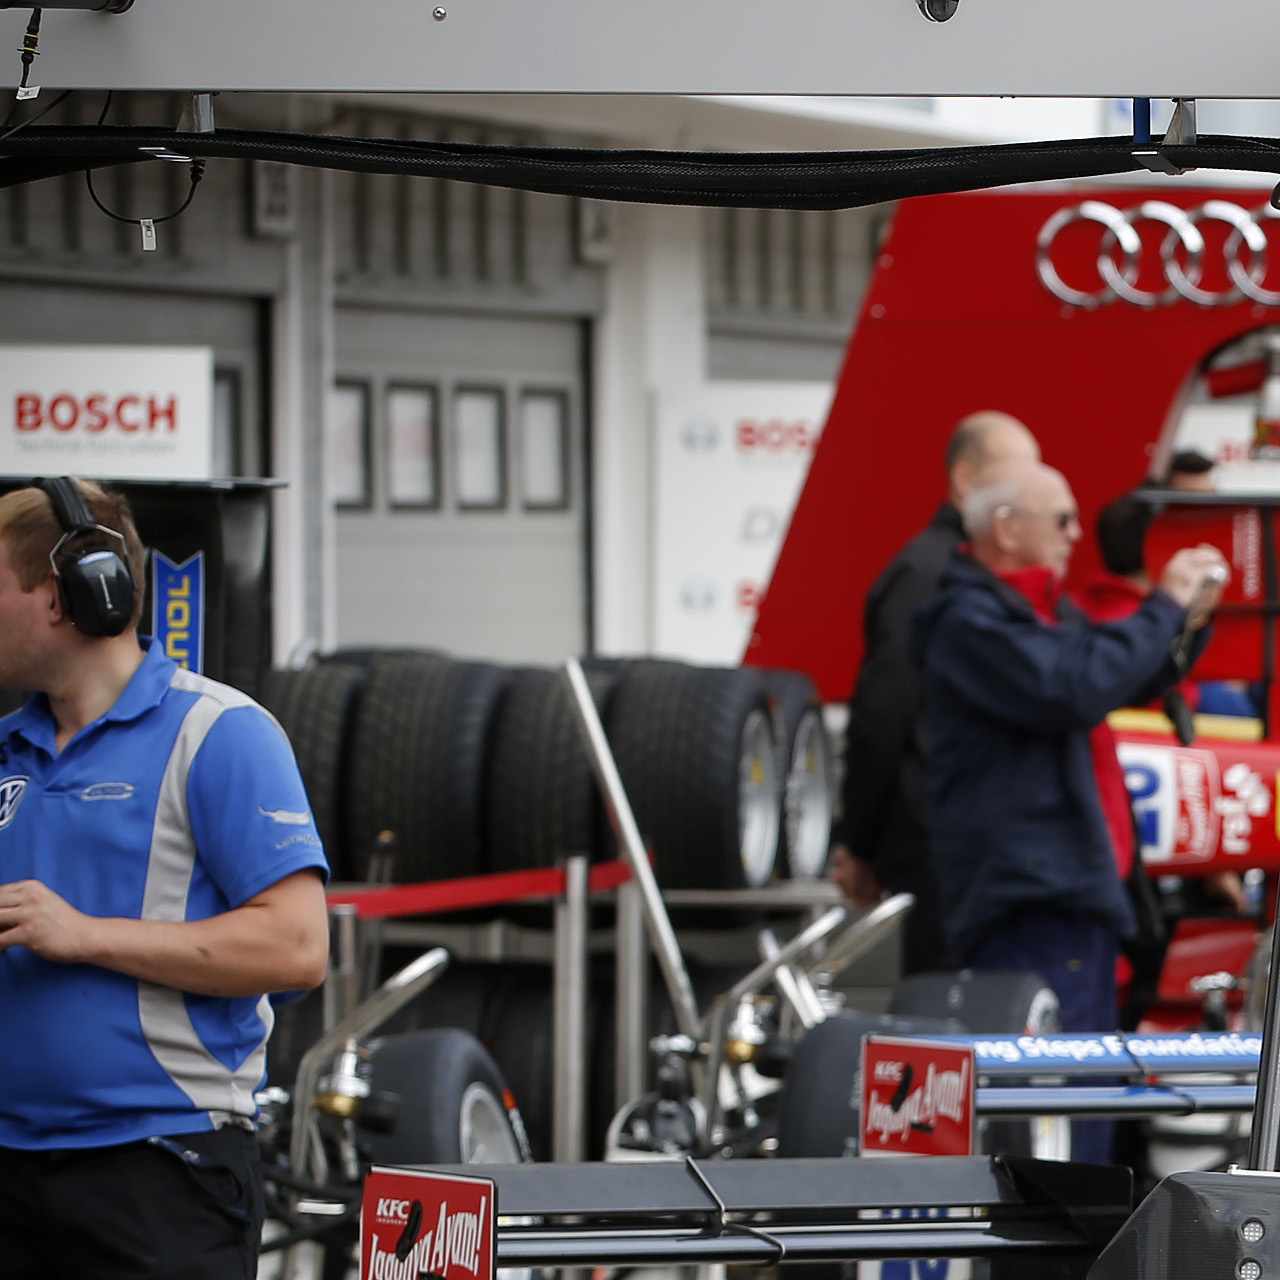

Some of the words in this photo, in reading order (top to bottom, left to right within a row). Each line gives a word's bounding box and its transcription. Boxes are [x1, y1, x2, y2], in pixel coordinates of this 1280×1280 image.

[15, 392, 178, 434] BOSCH
[736, 418, 818, 454] BOS
[1018, 1034, 1101, 1060] Steps
[1103, 1033, 1262, 1058] Foundatio
[376, 1197, 410, 1219] KFC
